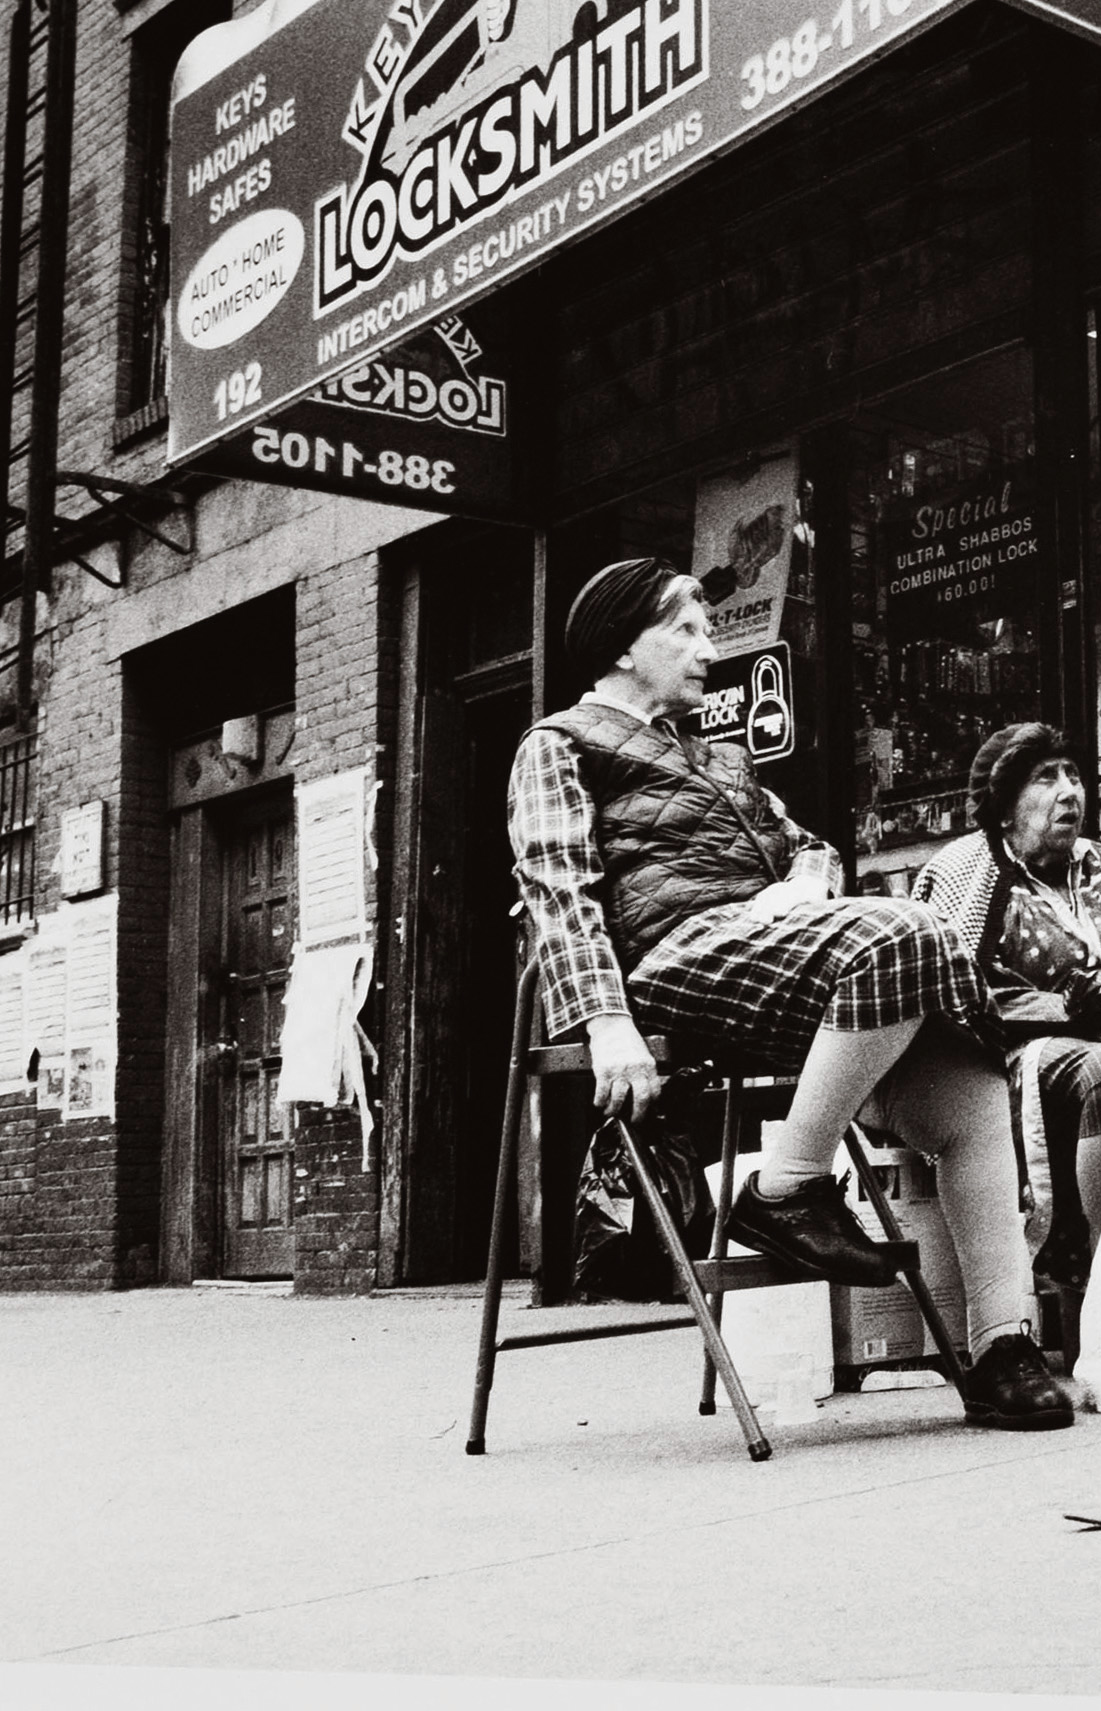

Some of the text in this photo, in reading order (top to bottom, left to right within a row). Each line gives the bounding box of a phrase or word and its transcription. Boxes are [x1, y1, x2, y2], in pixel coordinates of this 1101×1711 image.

[740, 0, 912, 110] 388-11
[215, 73, 267, 134] KEYS
[187, 98, 296, 197] HARDWARE
[320, 0, 700, 300] LOCKSMITH
[209, 158, 272, 224] SAFES
[191, 228, 285, 305] AUTO HOME
[318, 112, 703, 364] INTERCOM & SECURITY SYSTEMS
[191, 265, 287, 338] COMMERCIAL
[214, 362, 262, 421] 192
[912, 481, 1011, 538] Special
[890, 538, 1038, 594] COMBINATION LOCK
[897, 517, 1033, 570] ULTRA SHABBOS
[700, 685, 745, 711] RICAN
[701, 704, 741, 730] LOCK
